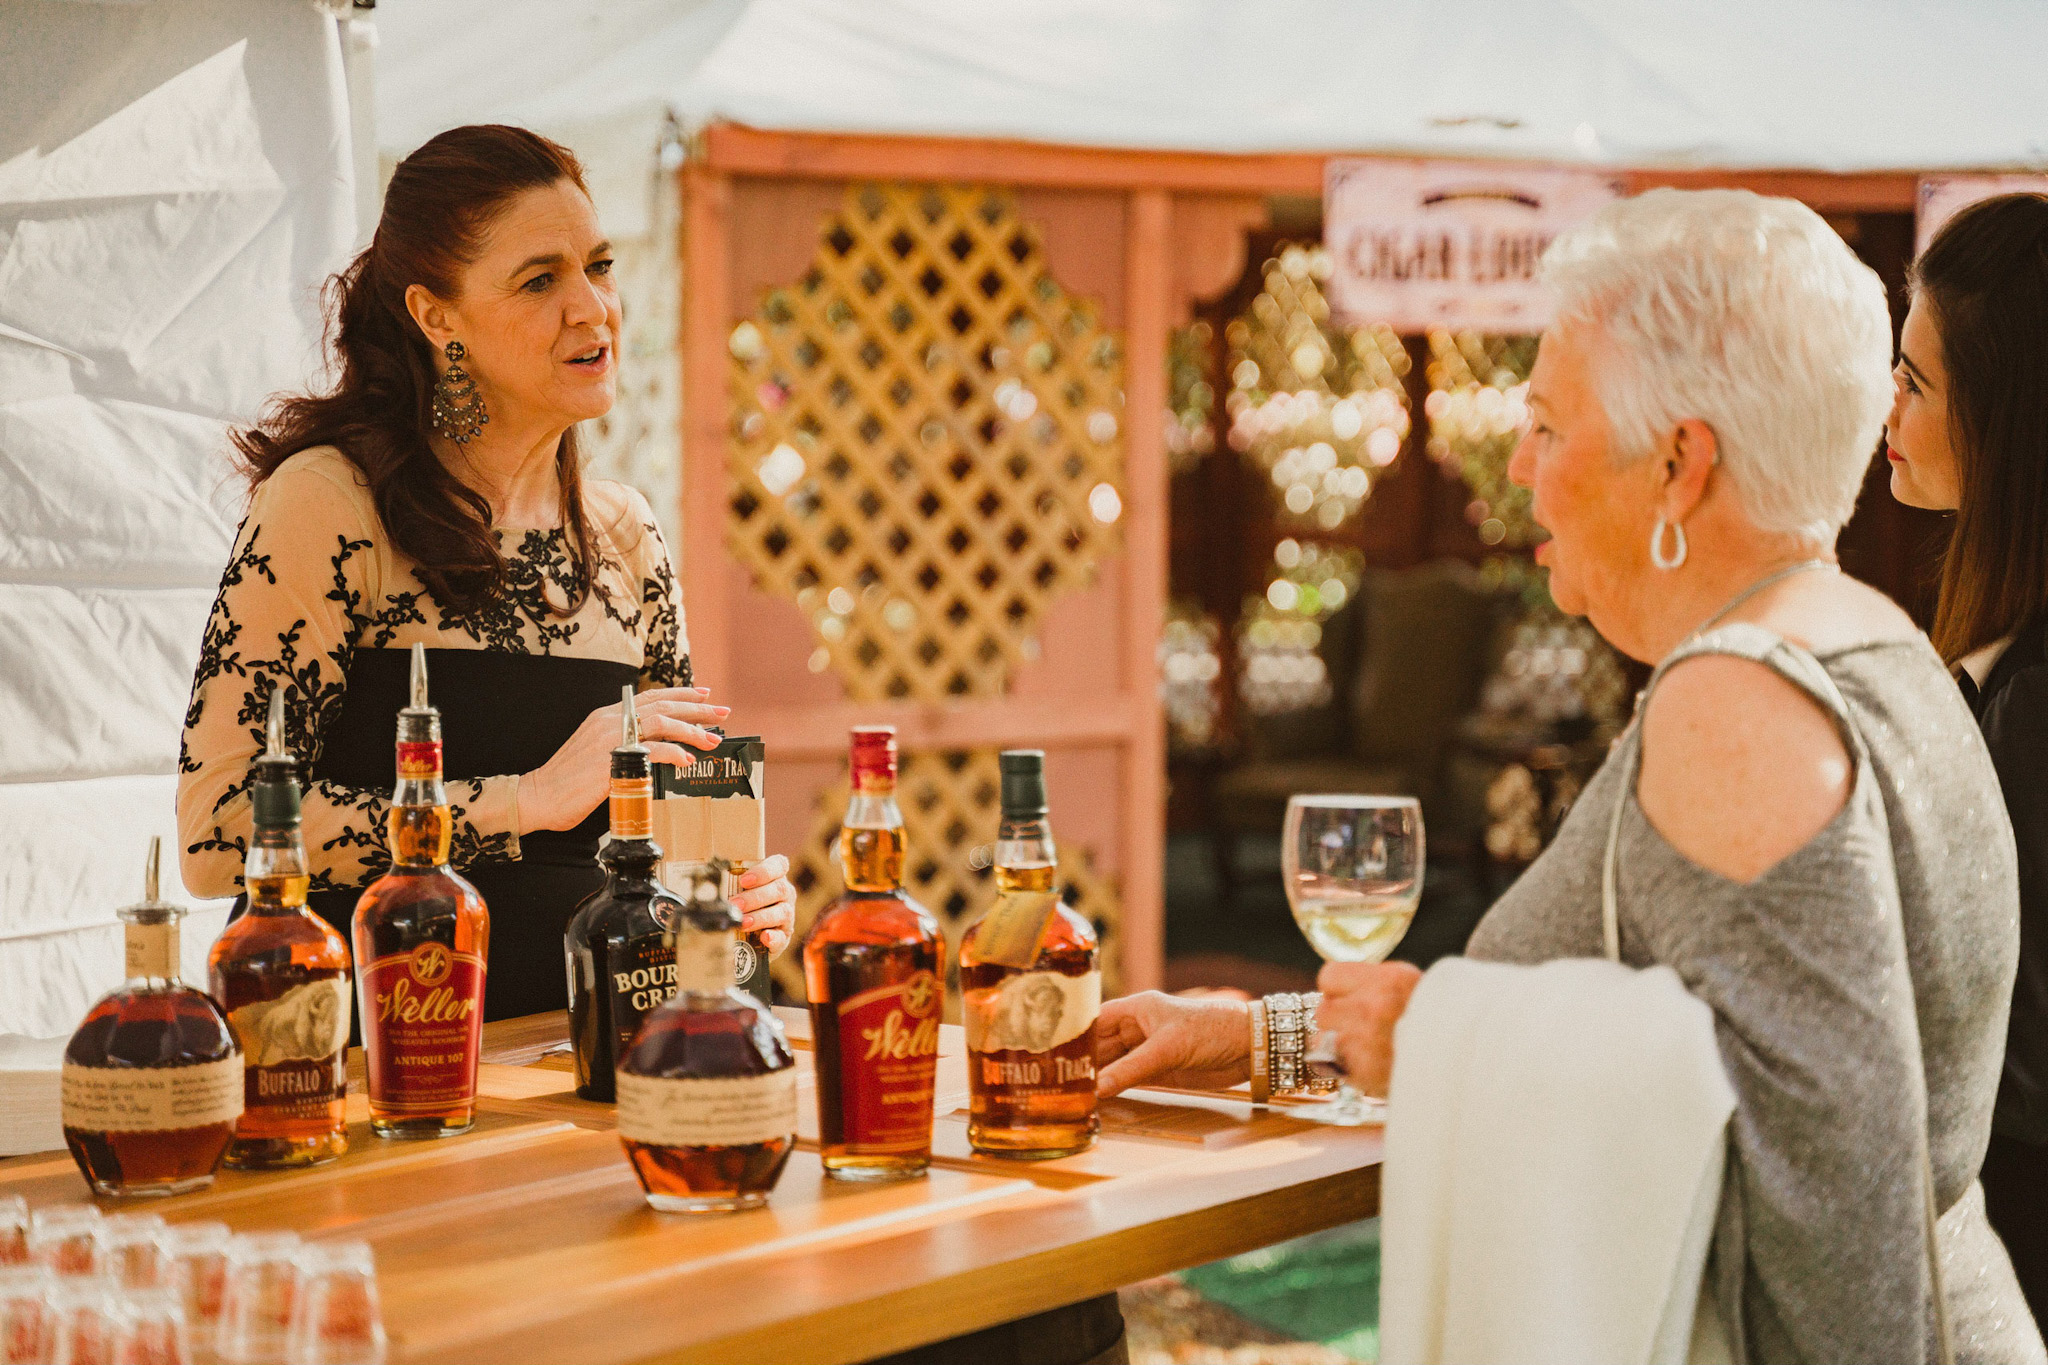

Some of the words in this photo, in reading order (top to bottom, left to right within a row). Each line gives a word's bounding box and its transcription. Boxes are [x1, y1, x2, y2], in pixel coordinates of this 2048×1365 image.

[675, 760, 714, 780] BUFFALO
[689, 778, 739, 786] DISTILLERY
[614, 964, 678, 993] BOUR
[377, 977, 475, 1024] Weller
[632, 986, 677, 1011] CRE
[861, 1009, 938, 1061] Well
[394, 1054, 445, 1067] ANTIQUE
[447, 1052, 464, 1063] 107
[982, 1057, 1041, 1086] BUFFALO
[258, 1069, 321, 1096] BUFFALO
